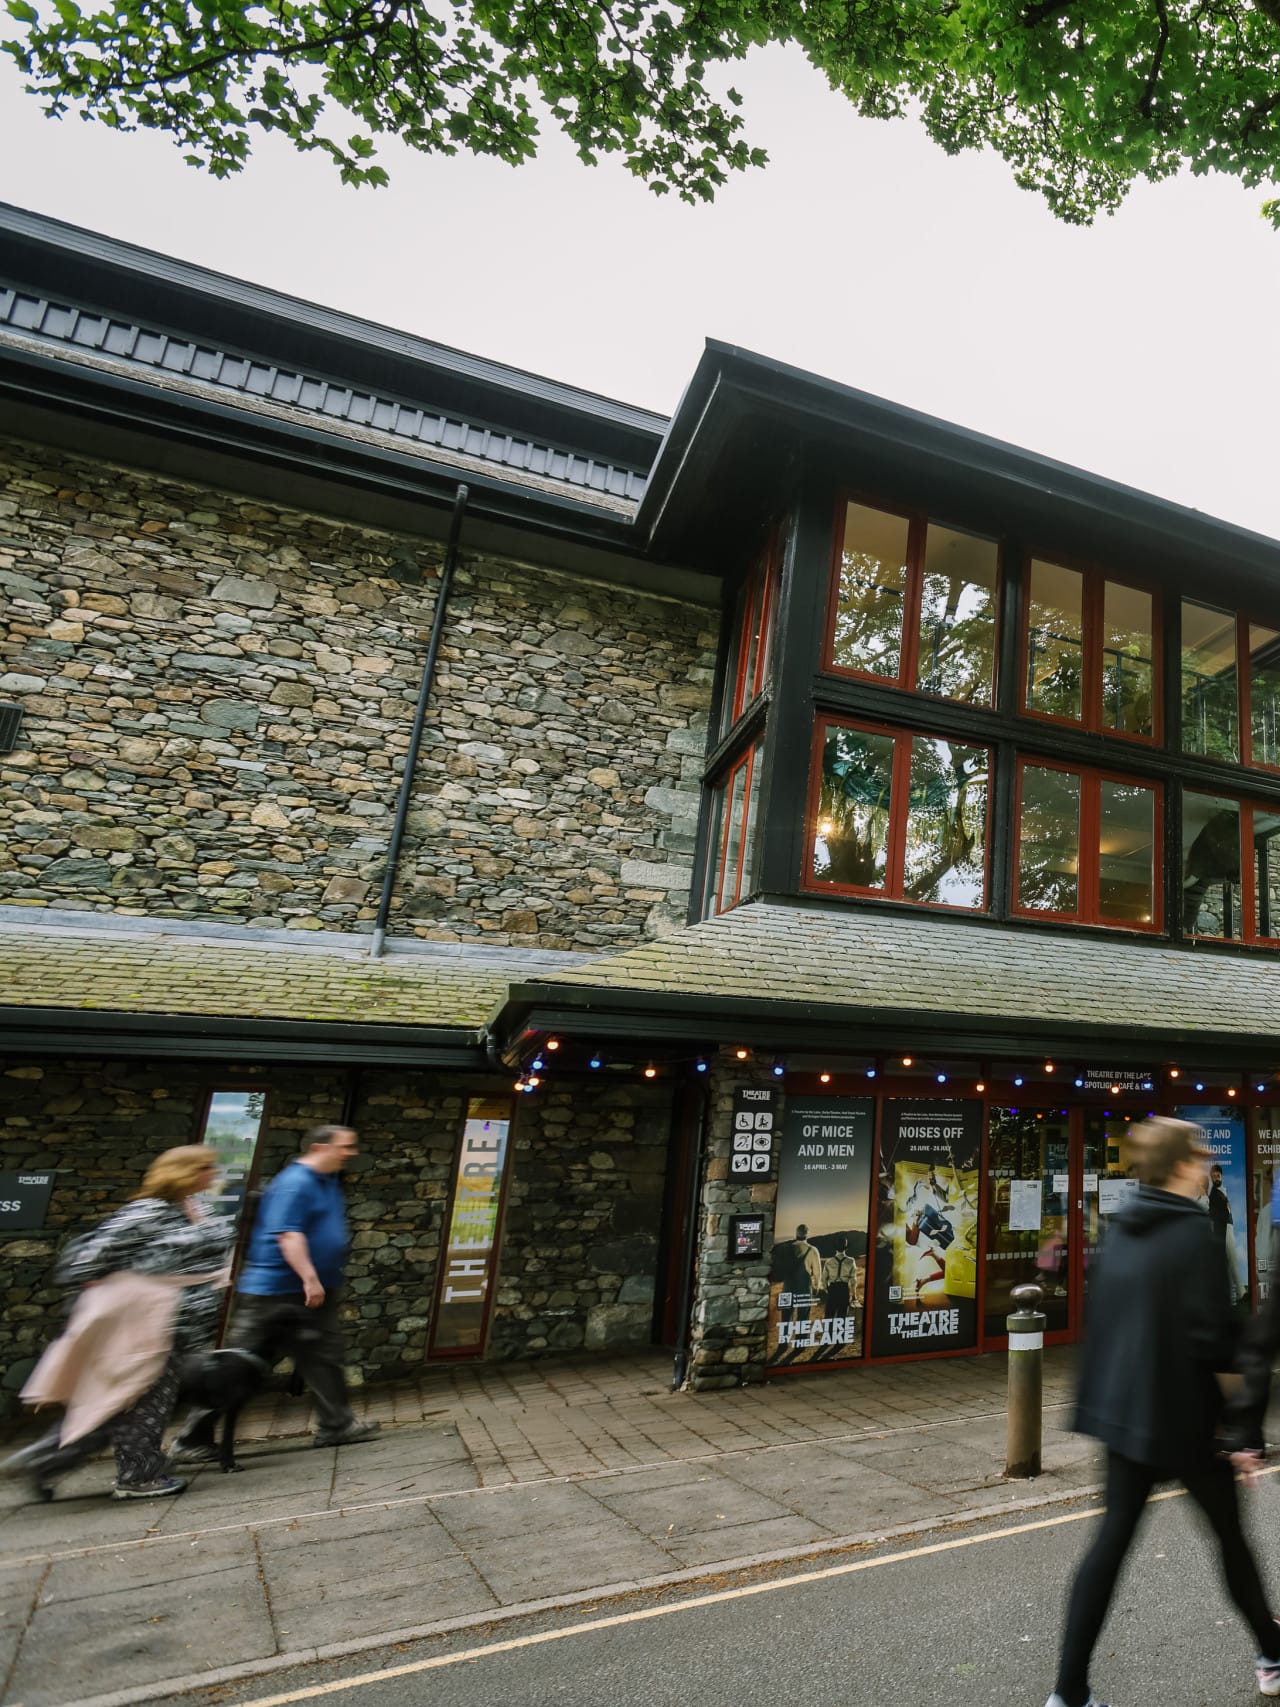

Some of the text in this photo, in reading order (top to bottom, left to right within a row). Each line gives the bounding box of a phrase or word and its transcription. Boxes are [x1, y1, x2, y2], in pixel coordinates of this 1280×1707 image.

[1087, 1070, 1113, 1078] THEATRE
[1114, 1071, 1122, 1079] BY
[1123, 1071, 1135, 1079] THE
[802, 1125, 854, 1138] OF MICE
[899, 1126, 964, 1139] NOISES OFF
[1213, 1129, 1231, 1139] AND
[1258, 1129, 1271, 1139] WE
[797, 1144, 855, 1157] AND MEN
[445, 1138, 501, 1304] THEATRE
[887, 1308, 960, 1327] THEATRE
[776, 1316, 856, 1336] THEATRE
[890, 1321, 959, 1339] BY THE LAKE
[778, 1330, 855, 1348] BY THE LAKE
